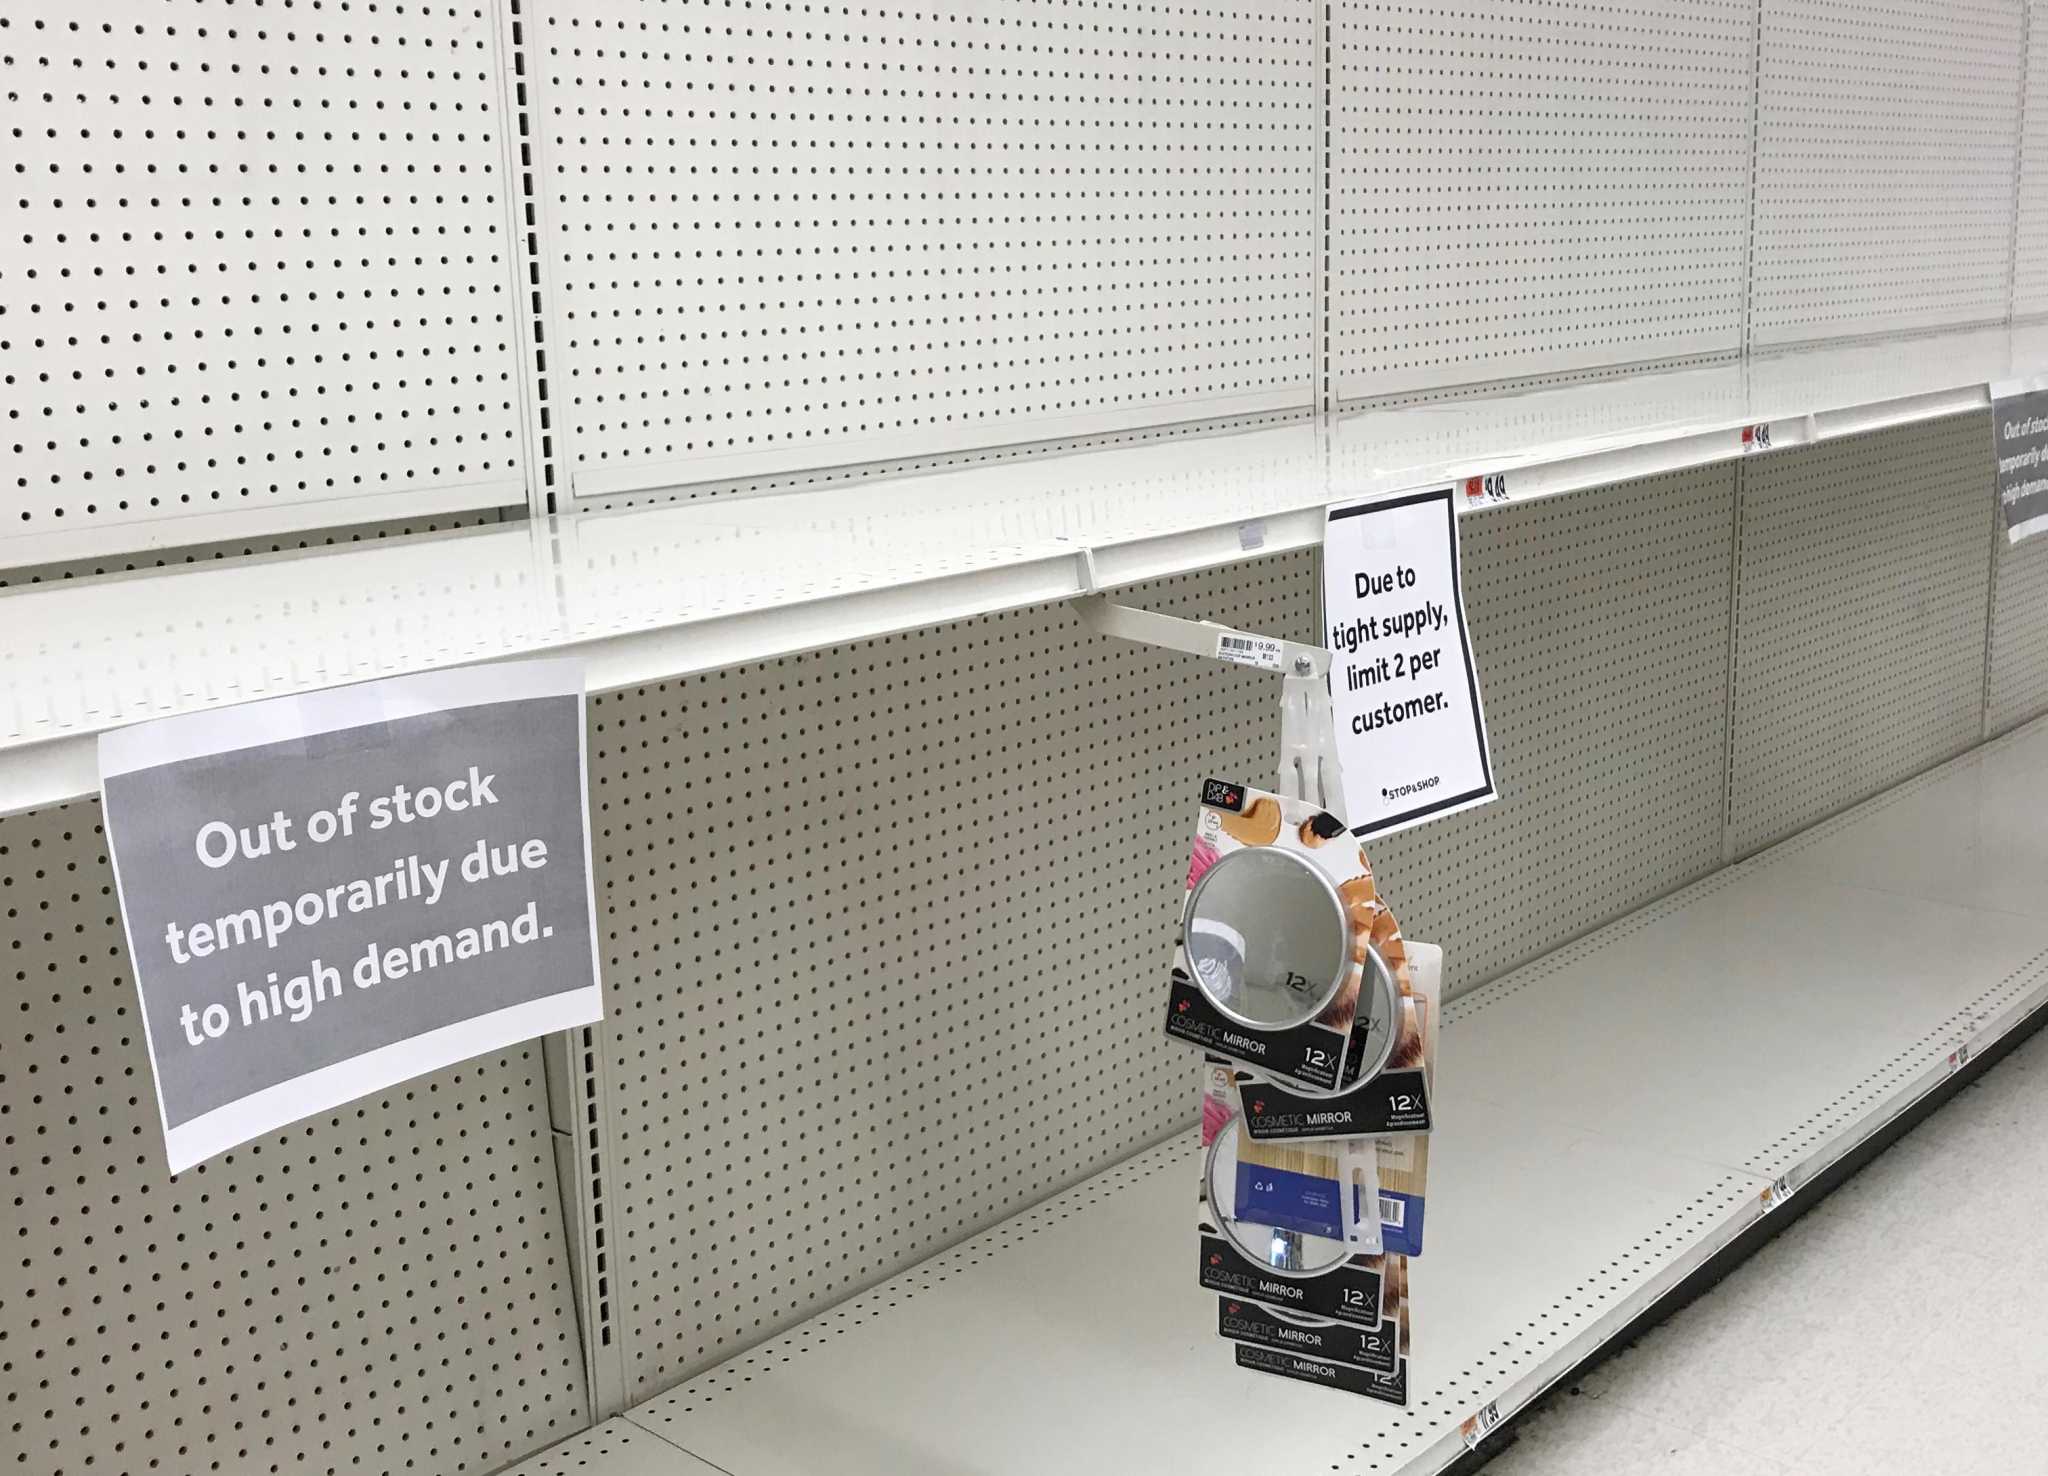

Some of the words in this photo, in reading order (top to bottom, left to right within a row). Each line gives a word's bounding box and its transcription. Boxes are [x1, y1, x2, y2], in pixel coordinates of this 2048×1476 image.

[2004, 421, 2020, 439] Out
[2021, 417, 2032, 436] of
[1355, 571, 1393, 598] Due
[1396, 565, 1416, 590] to
[1333, 617, 1379, 653] tight
[1382, 600, 1448, 638] supply,
[1347, 658, 1391, 691] limit
[1394, 653, 1405, 678] 2
[1410, 647, 1441, 680] per
[1351, 690, 1449, 735] customer.
[1388, 776, 1440, 800] STOP&SHOP
[195, 812, 297, 868] Out
[307, 791, 360, 843] of
[369, 766, 499, 830] stock
[165, 854, 450, 964] temporarily
[460, 836, 549, 883] due
[180, 1003, 230, 1046] to
[236, 958, 343, 1022] high
[352, 900, 554, 990] demand.
[1223, 1031, 1267, 1055] MIRROR
[1305, 1047, 1337, 1070] 12X
[1389, 1093, 1423, 1112] 12X
[1306, 1111, 1352, 1125] MIRROR
[1259, 1280, 1304, 1300] MIRROR
[1343, 1288, 1376, 1308] 12X
[1278, 1327, 1322, 1346] MIRROR
[1360, 1334, 1391, 1354] 12X
[1293, 1360, 1336, 1378] MIRROR
